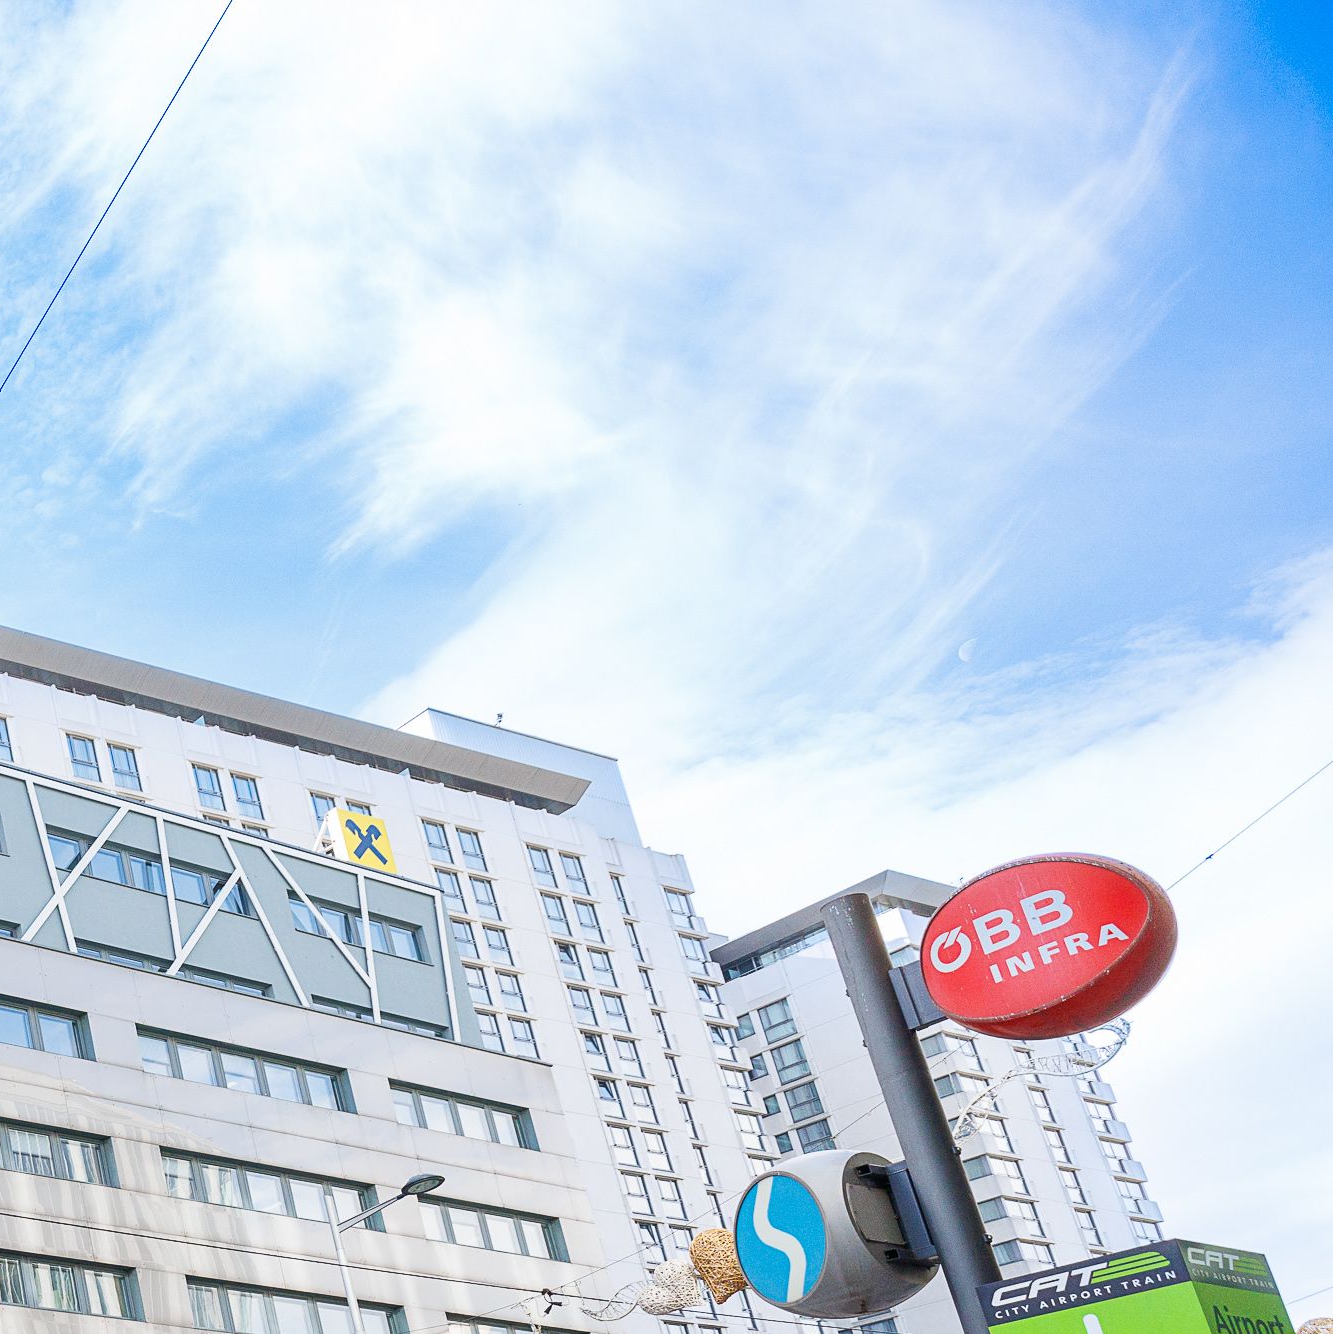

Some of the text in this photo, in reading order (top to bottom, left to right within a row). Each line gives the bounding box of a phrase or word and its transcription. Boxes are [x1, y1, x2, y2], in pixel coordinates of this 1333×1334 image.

[930, 889, 1074, 974] ÖBB
[990, 922, 1130, 984] INFRA
[1187, 1246, 1239, 1271] CAT
[1191, 1268, 1275, 1290] CITY AIRPORT TRAIN
[991, 1261, 1109, 1307] CAT
[995, 1270, 1176, 1319] CITY AIRPORT TRAIN
